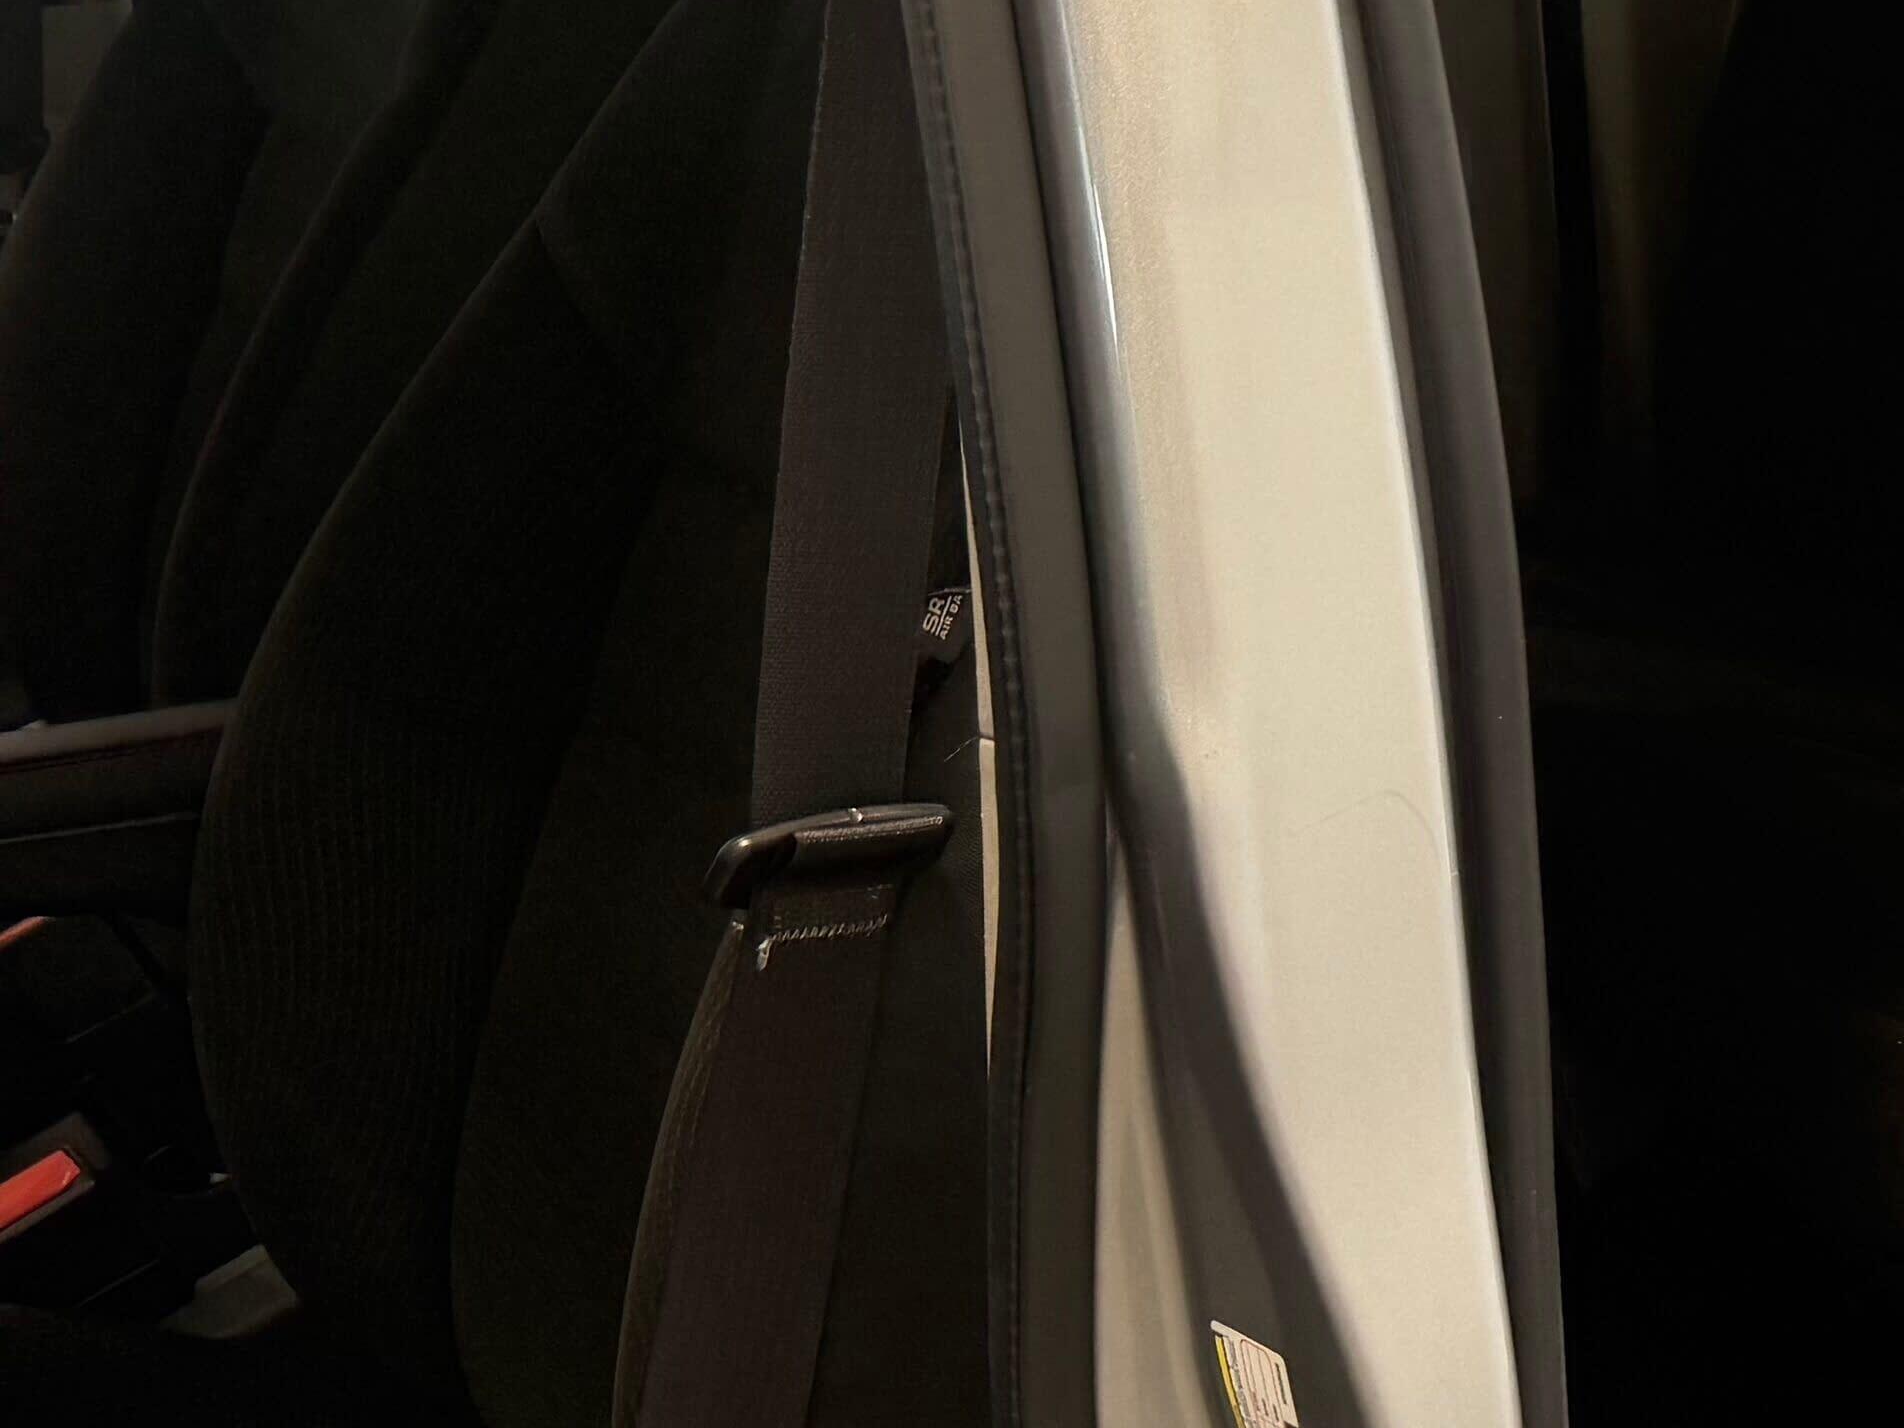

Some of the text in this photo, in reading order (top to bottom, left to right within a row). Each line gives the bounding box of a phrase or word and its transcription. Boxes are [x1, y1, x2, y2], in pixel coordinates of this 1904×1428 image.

[922, 597, 945, 634] SR
[940, 595, 964, 641] AIR BA
